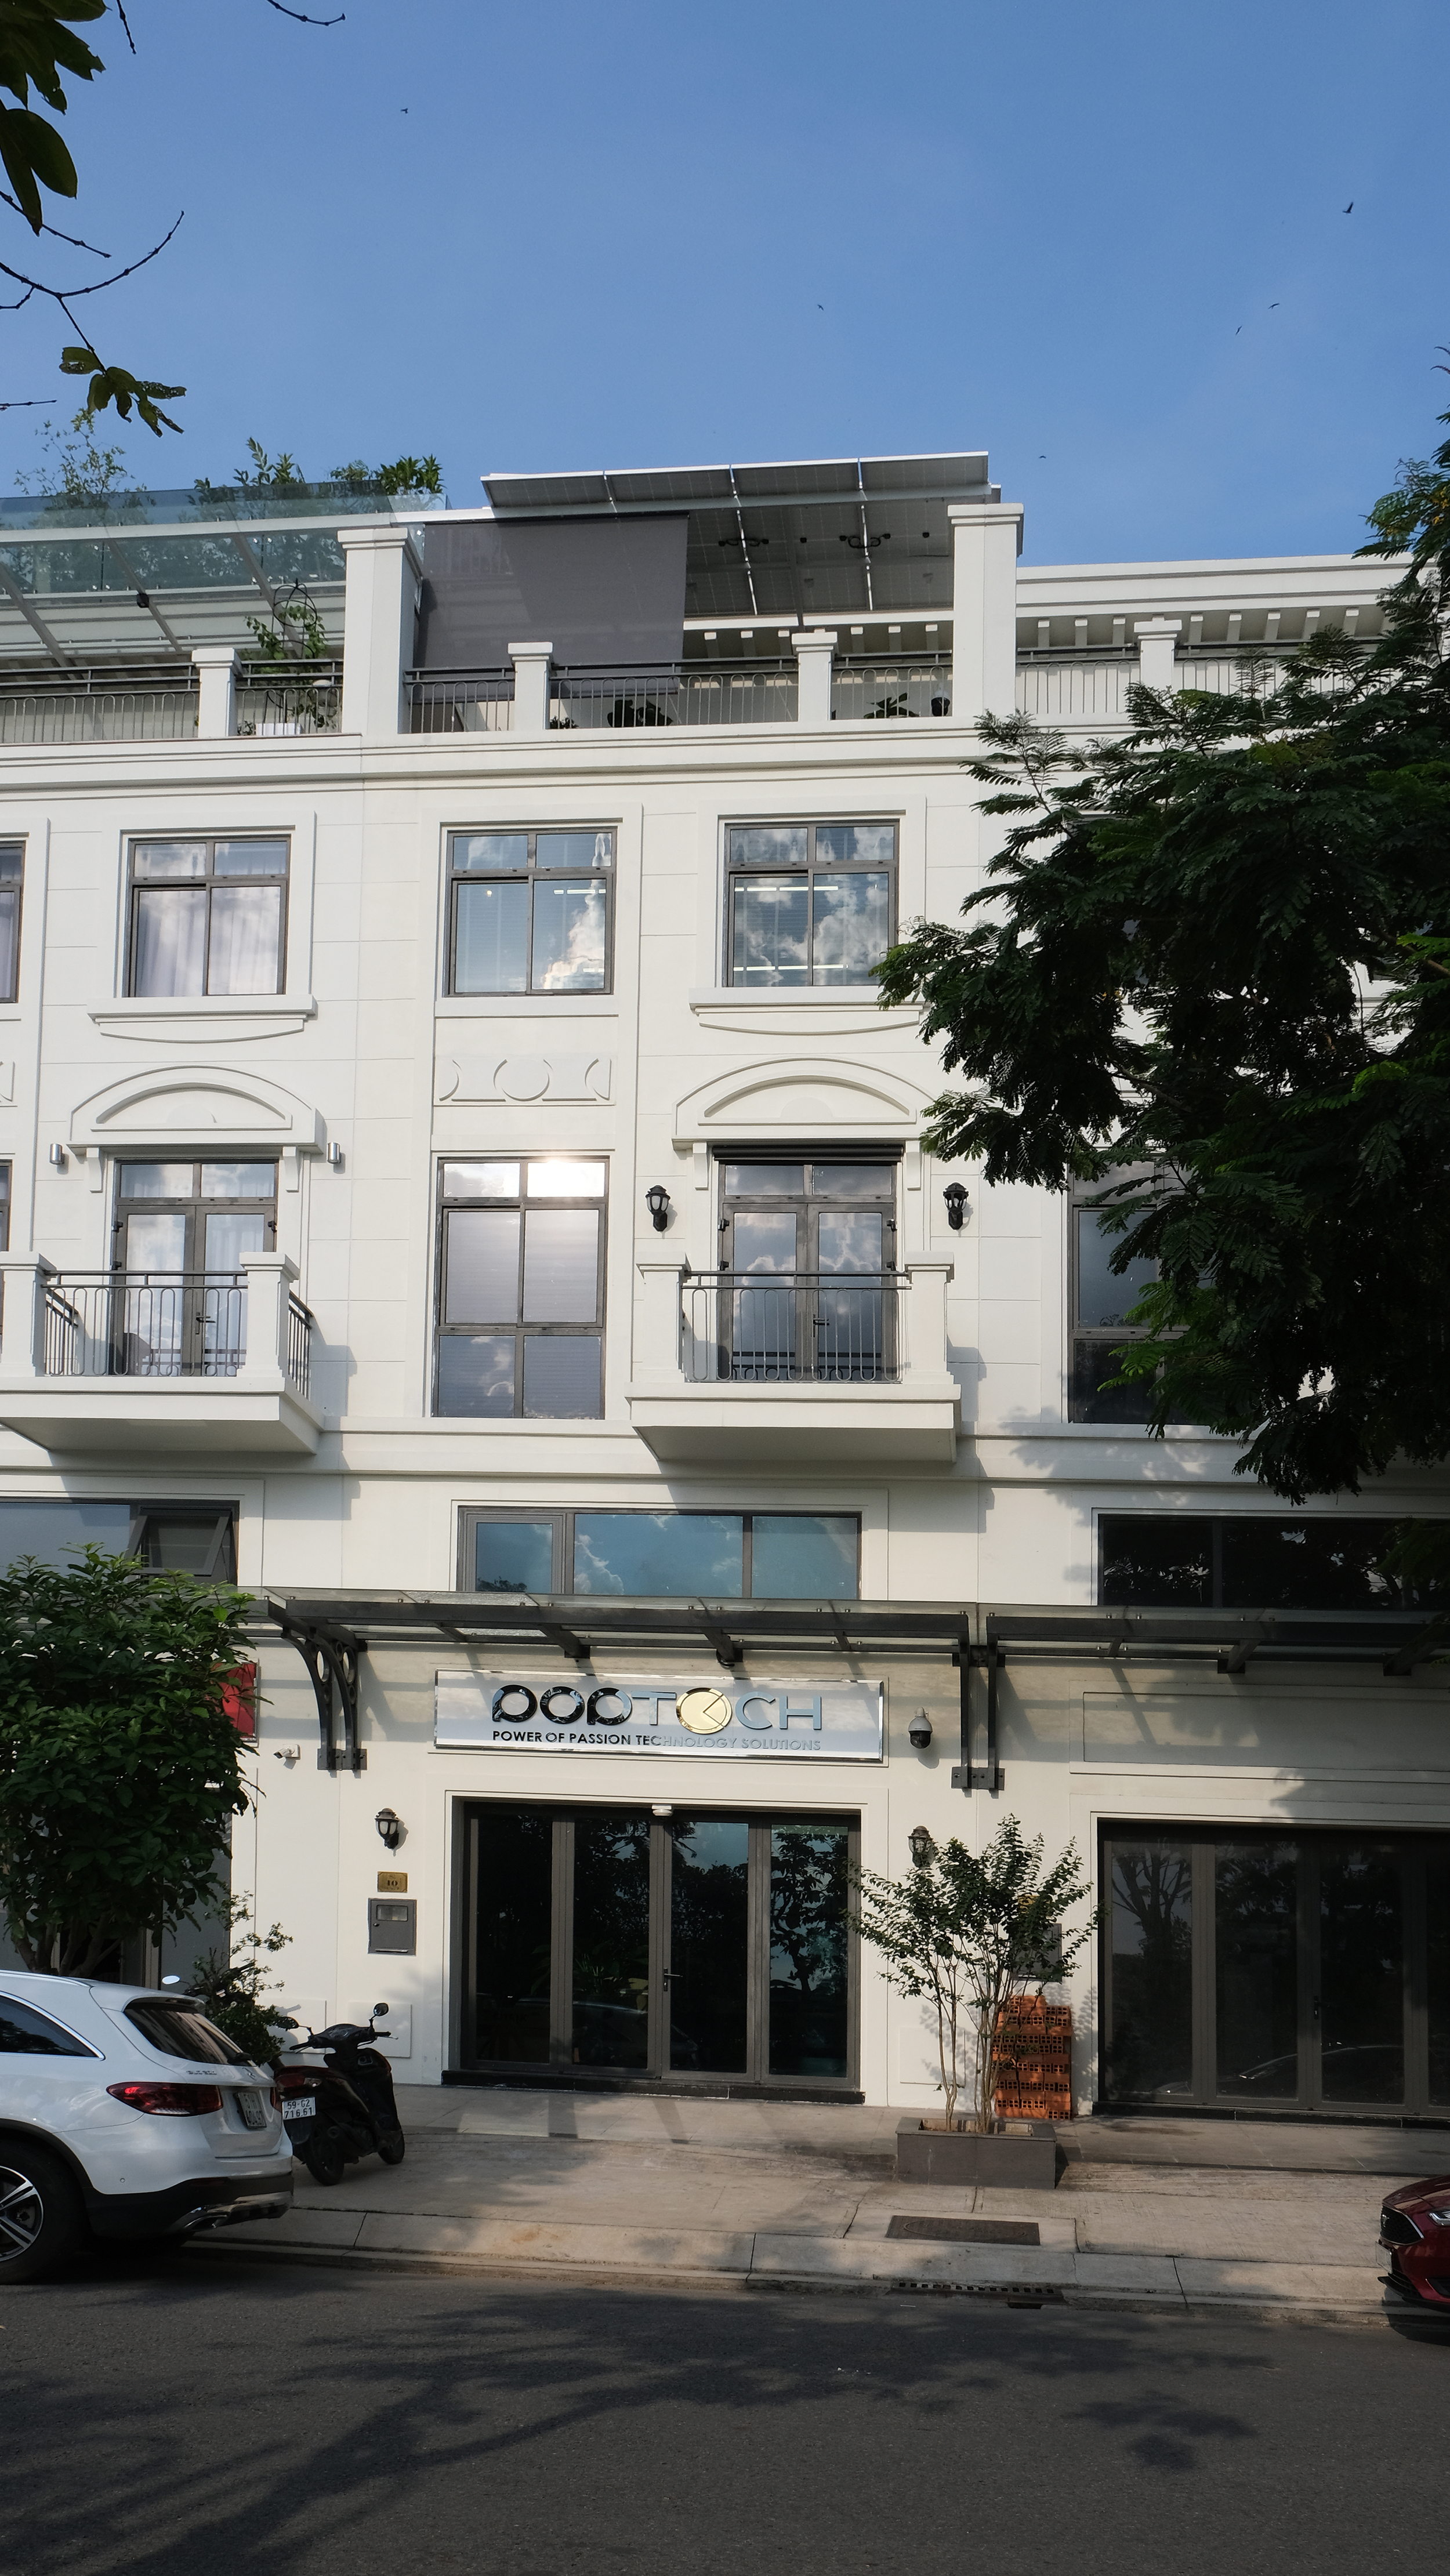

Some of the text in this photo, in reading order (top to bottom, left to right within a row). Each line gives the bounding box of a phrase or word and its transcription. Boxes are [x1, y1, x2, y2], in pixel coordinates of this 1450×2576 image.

[493, 1730, 821, 1751] POWER OF PASSION TECHNOLOGY SOLUTIONS
